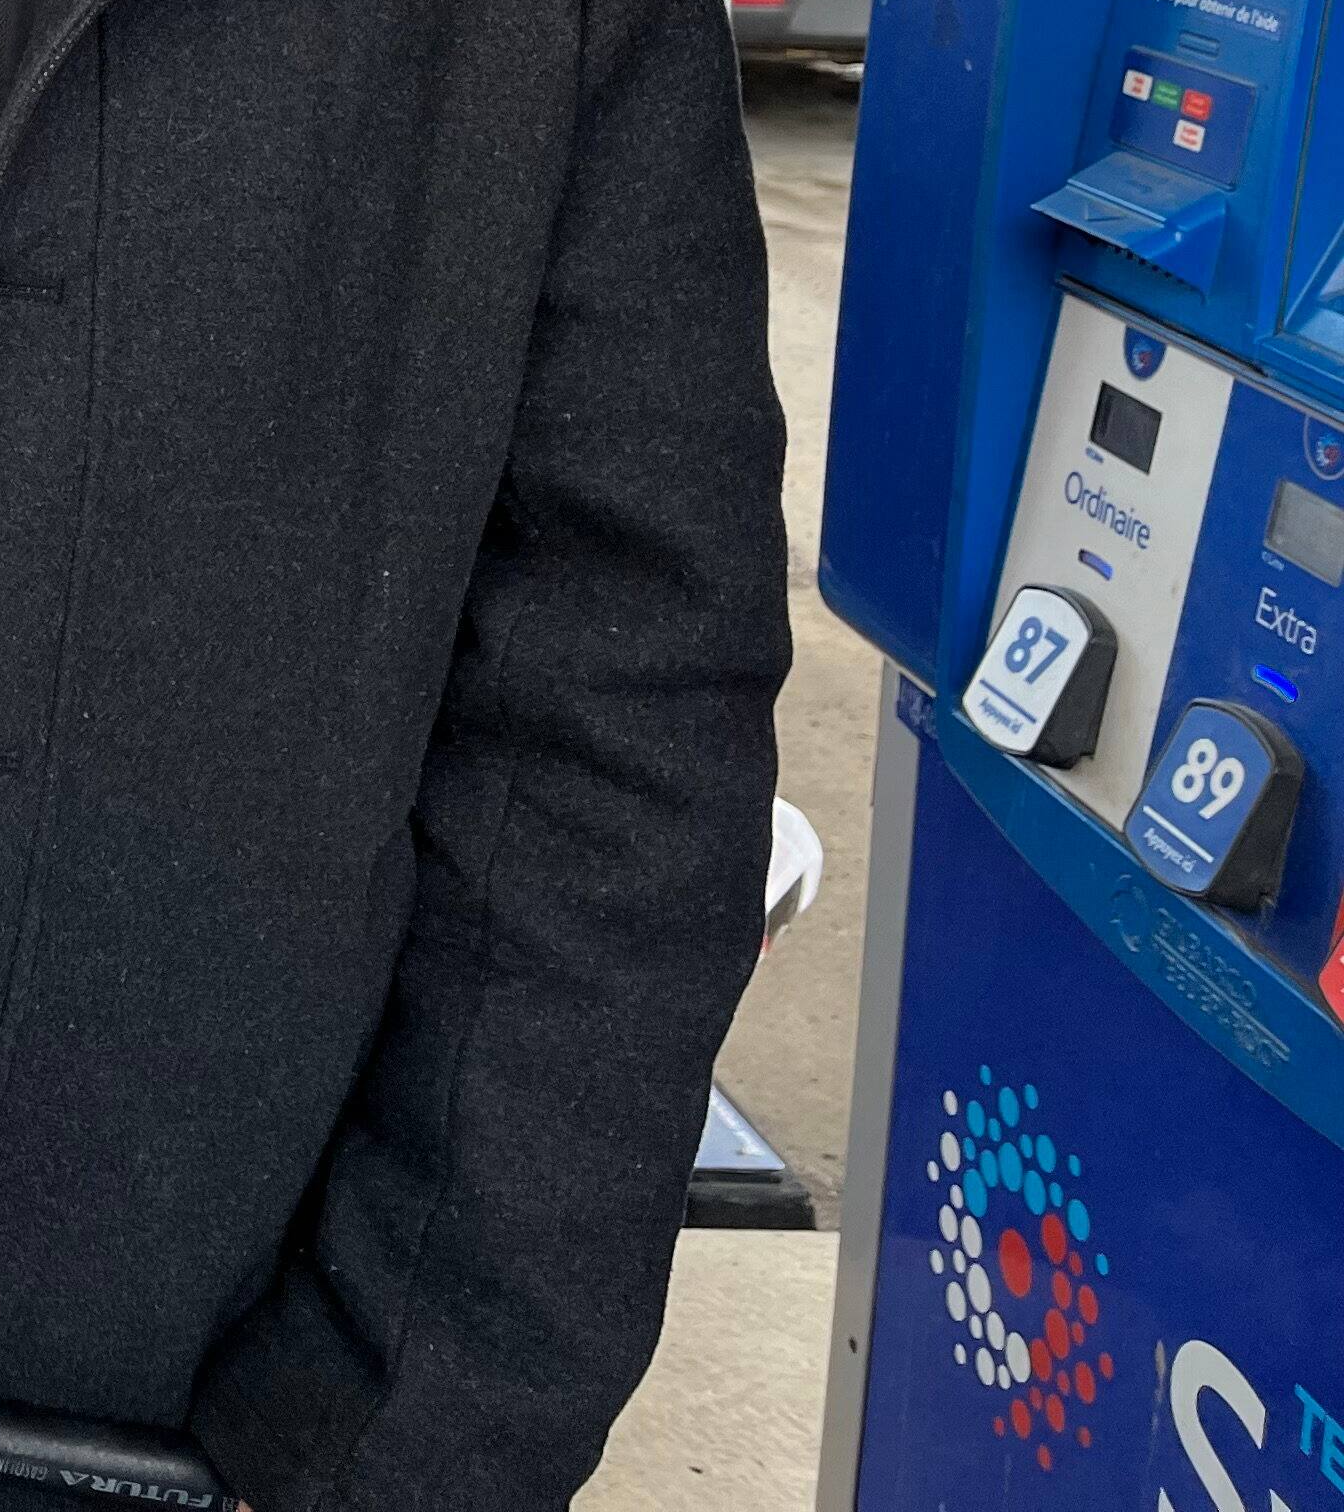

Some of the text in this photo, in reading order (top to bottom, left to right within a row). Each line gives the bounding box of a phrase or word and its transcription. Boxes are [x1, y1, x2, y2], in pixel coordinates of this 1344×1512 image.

[1064, 471, 1150, 549] Ordinaire
[1005, 616, 1069, 685] 87
[1254, 586, 1317, 656] Extra
[1171, 738, 1246, 820] 89
[58, 1468, 214, 1508] FUTURA
